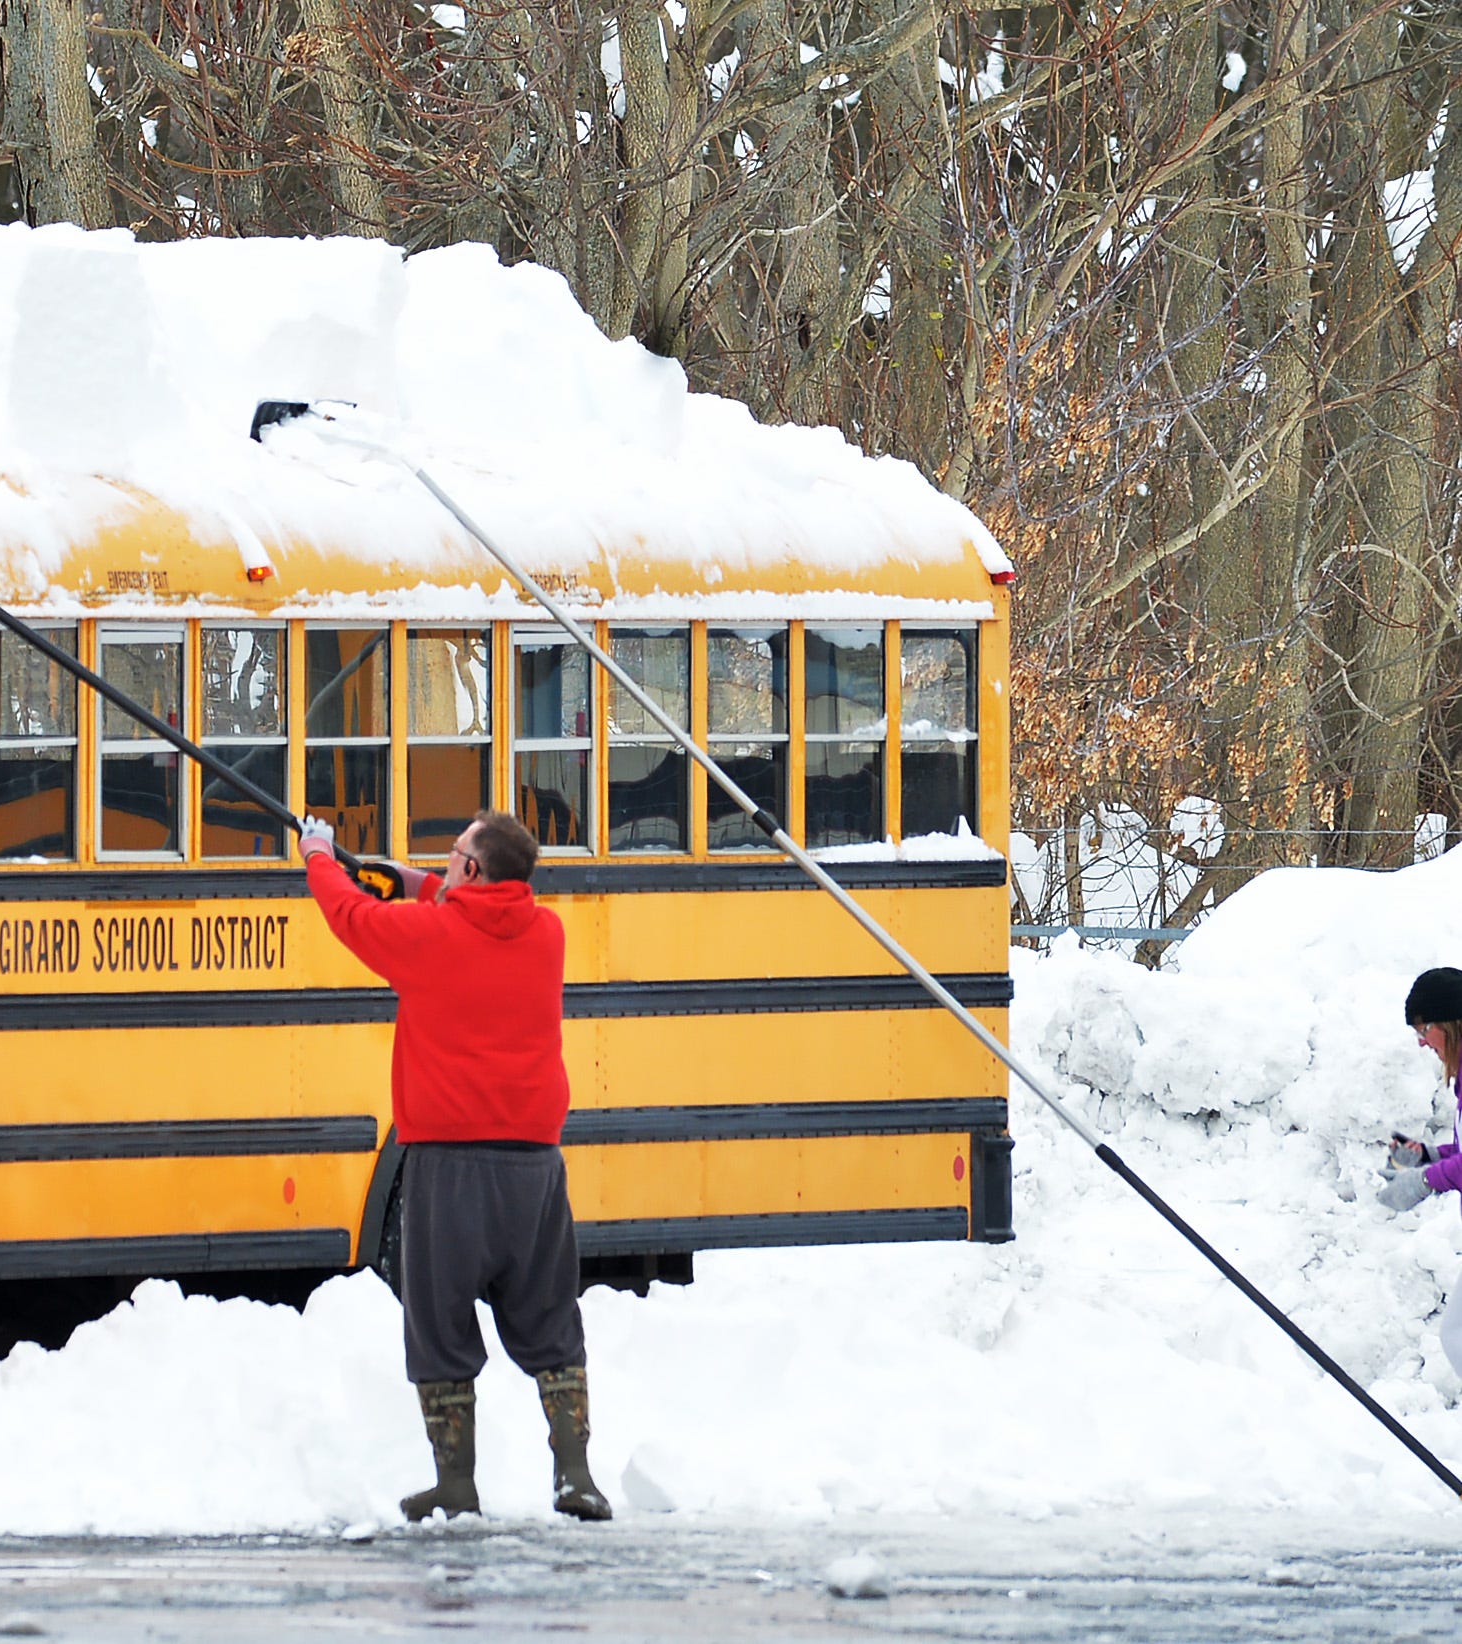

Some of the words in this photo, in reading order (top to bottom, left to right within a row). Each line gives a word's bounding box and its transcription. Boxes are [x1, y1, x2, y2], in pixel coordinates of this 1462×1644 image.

[152, 571, 170, 589] EXIT
[92, 916, 178, 972] SCHOOL
[191, 915, 288, 970] DISTRICT
